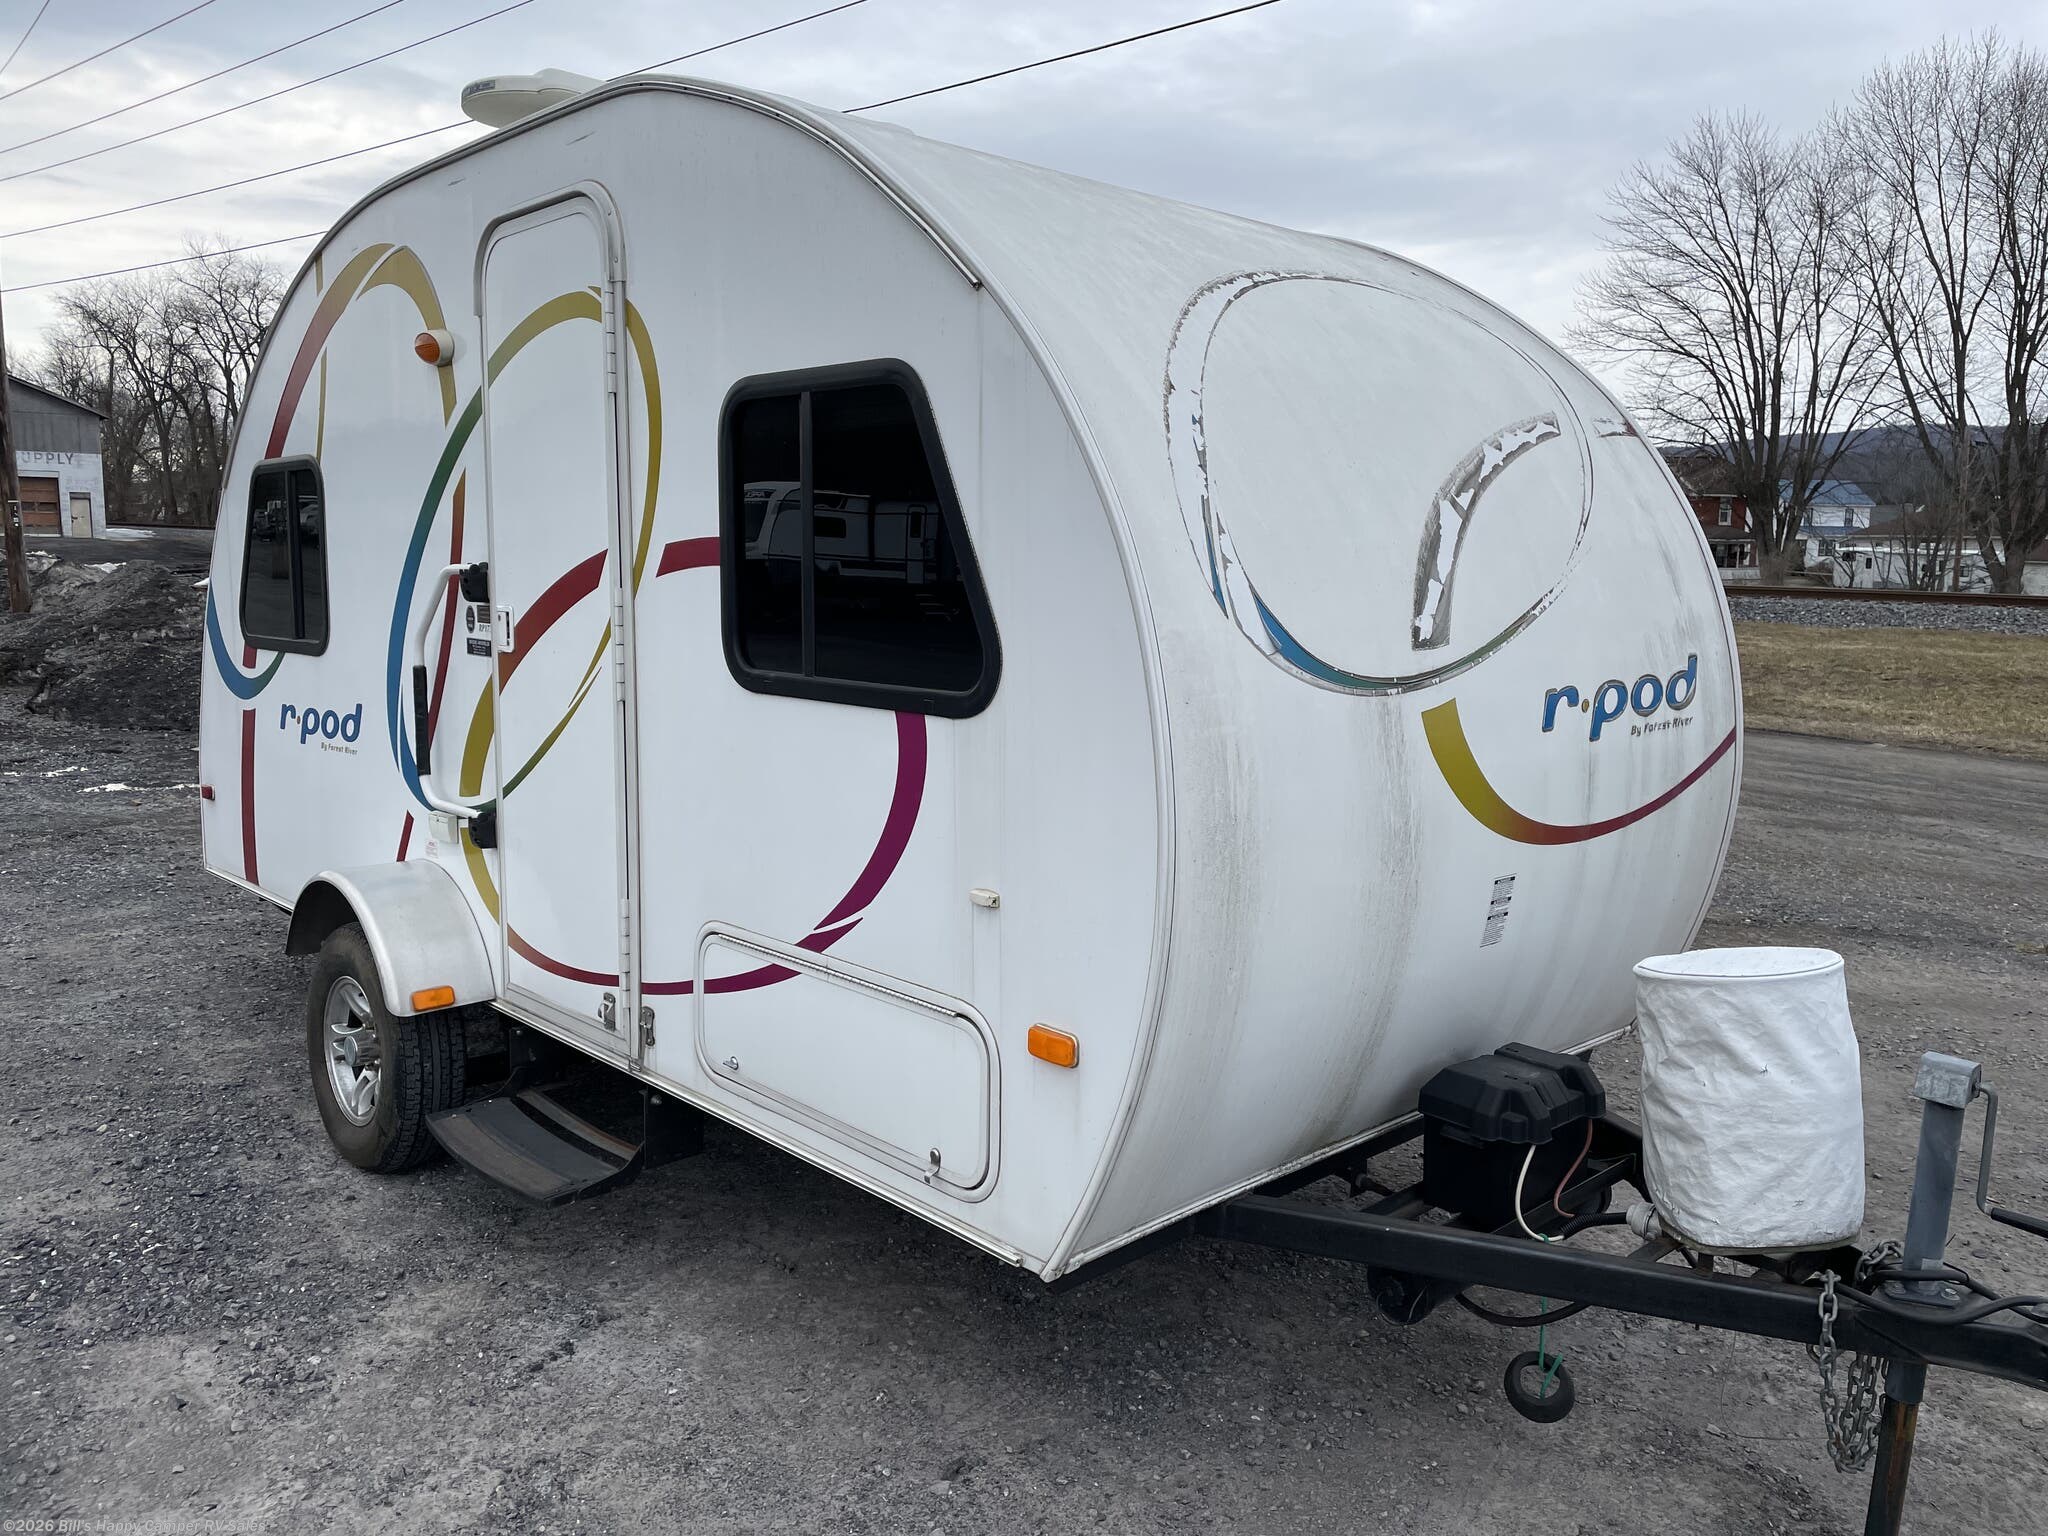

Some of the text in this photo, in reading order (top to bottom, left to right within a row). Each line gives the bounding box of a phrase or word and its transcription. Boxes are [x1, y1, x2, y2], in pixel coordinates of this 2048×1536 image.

[21, 451, 74, 465] UPPLY
[1631, 725, 1641, 736] By
[1672, 716, 1693, 728] River
